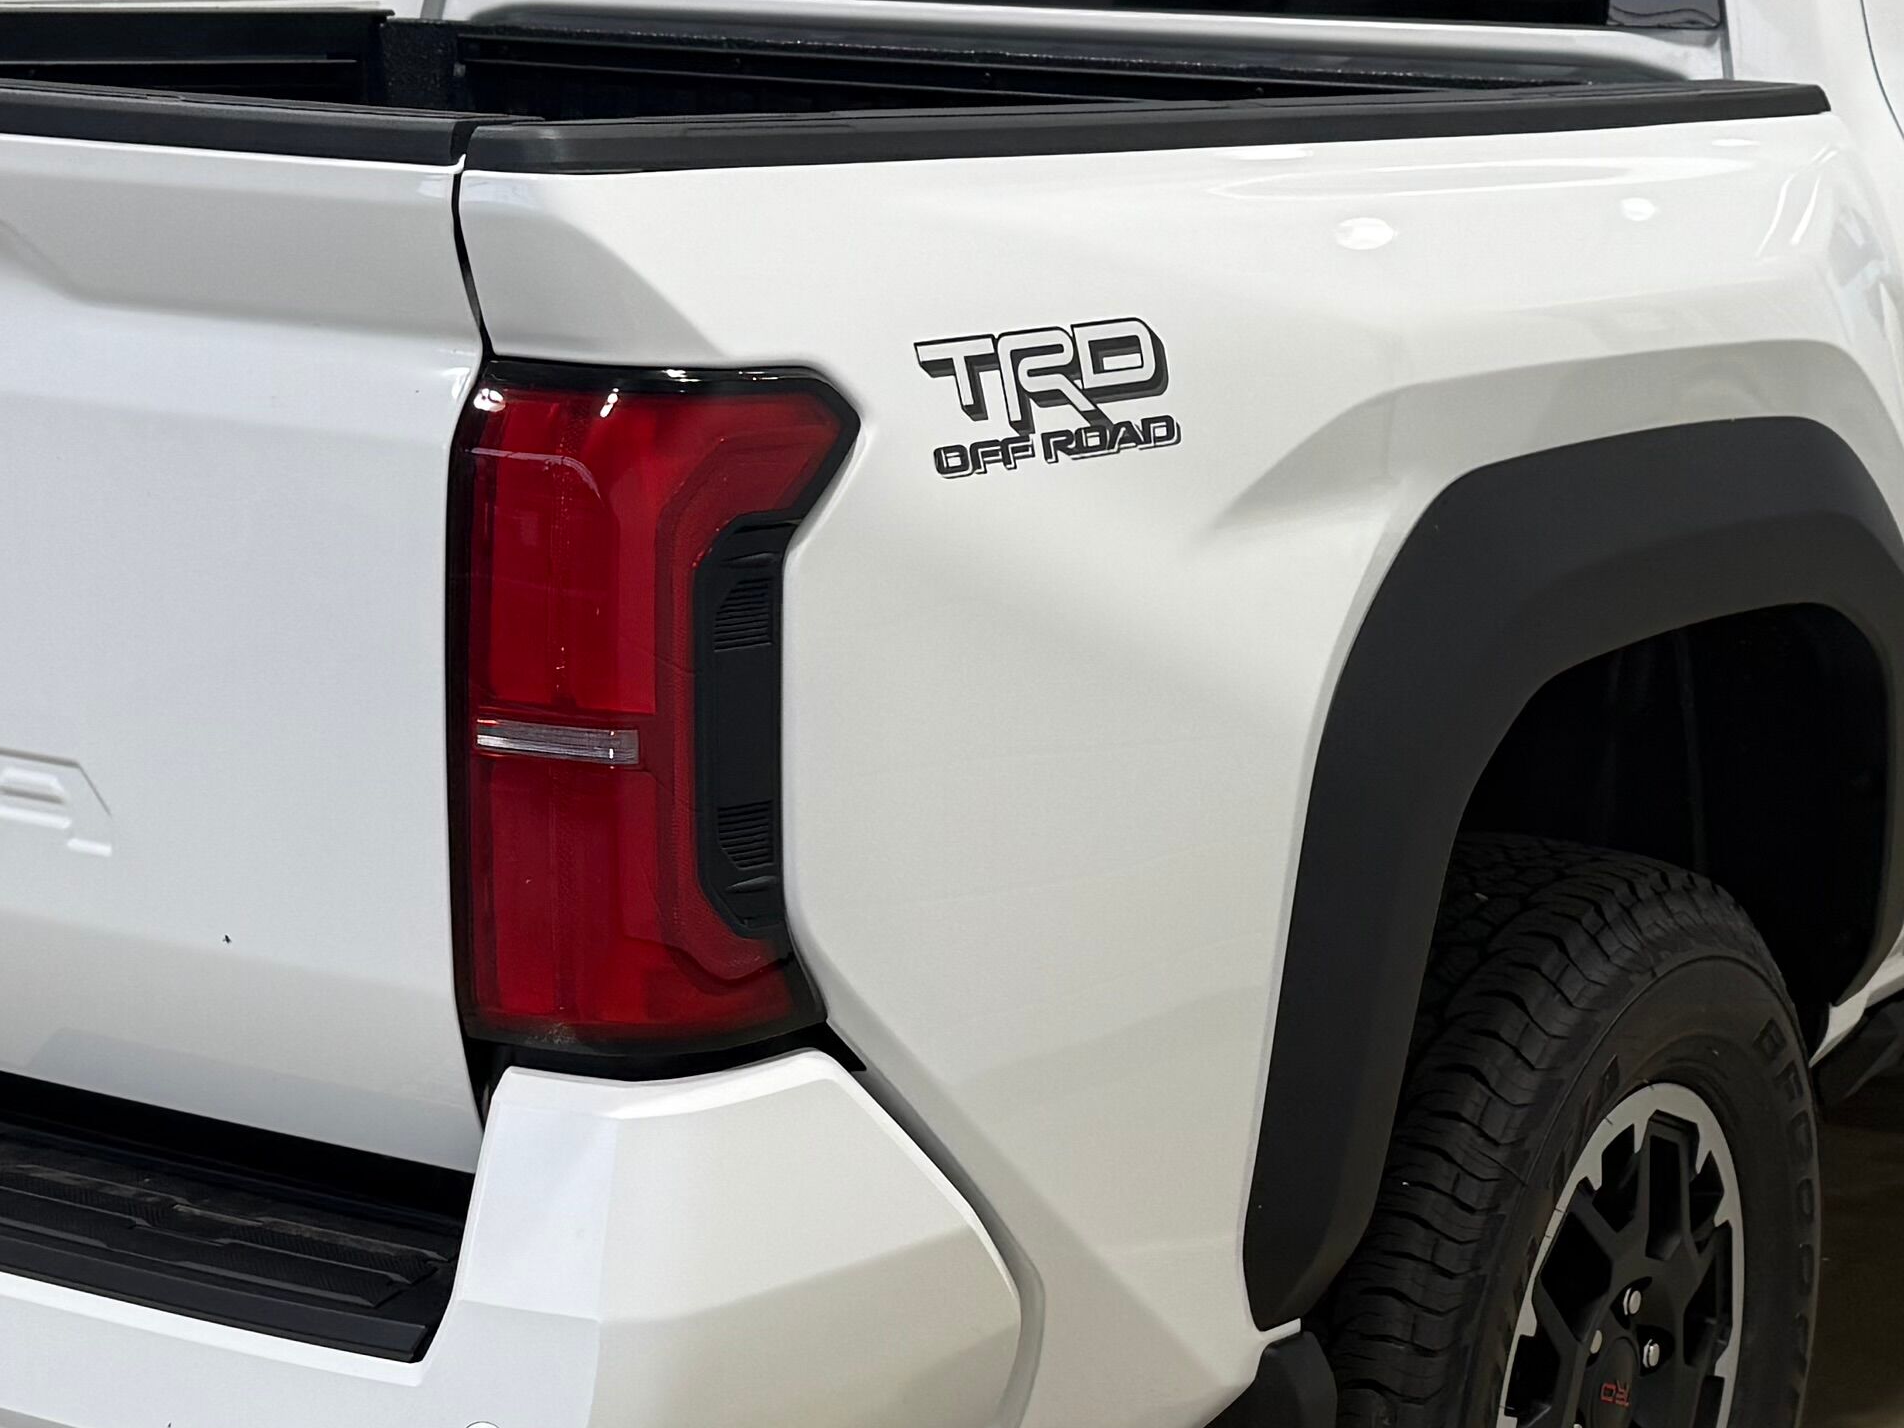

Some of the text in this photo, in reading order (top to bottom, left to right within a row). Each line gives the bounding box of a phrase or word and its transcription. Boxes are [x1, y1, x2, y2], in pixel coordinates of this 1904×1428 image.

[913, 316, 1170, 436] TRD
[933, 413, 1182, 480] OFF ROAD
